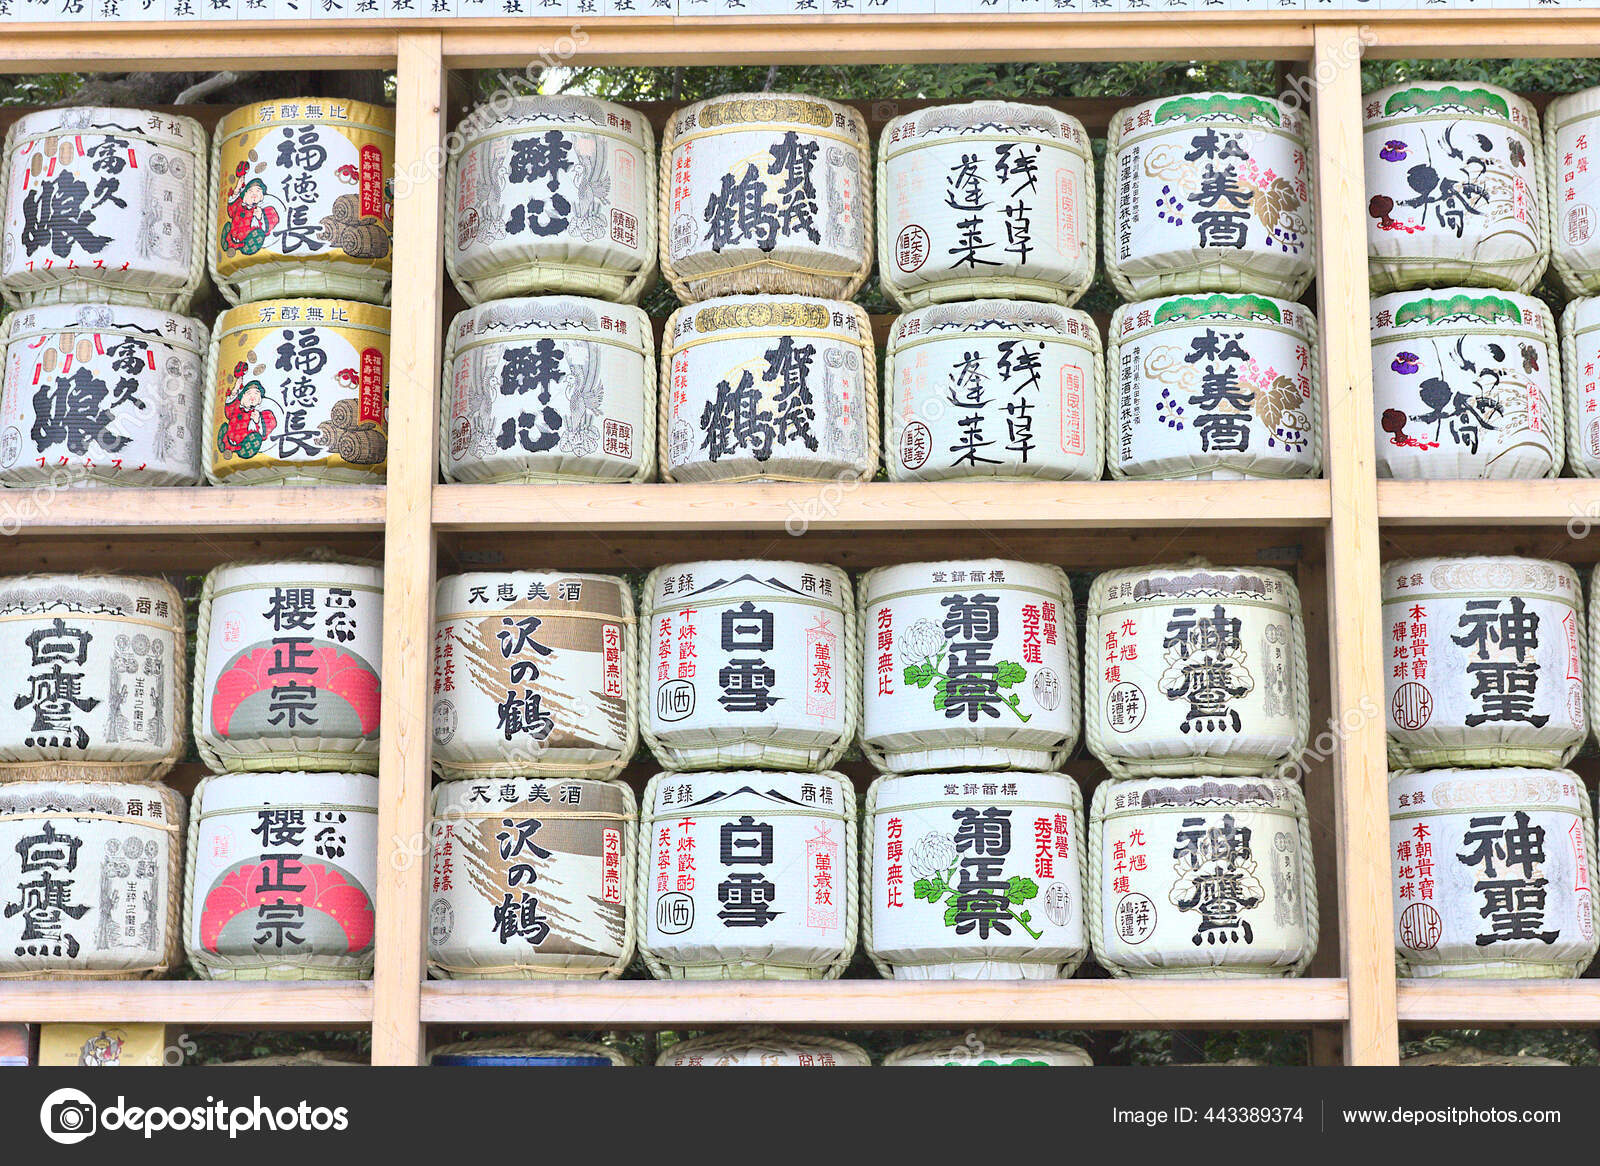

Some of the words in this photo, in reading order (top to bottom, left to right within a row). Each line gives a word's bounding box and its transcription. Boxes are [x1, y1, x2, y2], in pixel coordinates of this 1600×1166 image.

[259, 104, 348, 122] 芳醇無比
[607, 112, 632, 134] 商標
[272, 124, 328, 254] 福徳長
[1120, 154, 1132, 260] 中澤酒造株式会社
[25, 259, 130, 272] フクムスメ
[259, 306, 349, 323] 芳醇無比
[600, 316, 628, 335] 商標
[270, 327, 328, 459] 福徳長
[1295, 345, 1311, 399] 清酒
[1120, 354, 1133, 461] 中澤酒造株式会社
[36, 456, 147, 471] フクムスメ
[136, 596, 168, 618] 商標
[468, 582, 582, 604] 天恵美酒
[801, 573, 833, 597] 商標
[932, 570, 1006, 583] 登録商標
[263, 587, 319, 728] 櫻正宗
[606, 629, 621, 694] 芳醇無比
[657, 618, 672, 682] 芙蓉霞
[717, 601, 786, 712] 白雪
[877, 607, 894, 697] 芳醇無比
[941, 593, 1002, 722] 菊正宗
[1022, 604, 1043, 665] 秀天涯
[1120, 619, 1138, 662] 光輝
[1392, 621, 1409, 681] 輝地球
[1450, 596, 1551, 728] 神聖
[14, 618, 101, 749] 白鷹
[496, 616, 554, 741] 沢の鶴
[1163, 605, 1249, 734] 神鷹
[127, 799, 163, 818] 商標
[469, 784, 582, 804] 天恵美酒
[801, 783, 833, 804] 商標
[944, 783, 1018, 796] 登録商標
[251, 802, 307, 947] 櫻正宗
[605, 833, 619, 899] 芳醇無比
[657, 828, 671, 892] 芙蓉霞
[717, 816, 787, 928] 白雪
[887, 818, 904, 909] 芳醇無比
[952, 807, 1013, 940] 菊正宗
[1034, 817, 1054, 879] 秀天涯
[1129, 828, 1148, 872] 光輝
[1173, 814, 1259, 946] 神鷹
[1397, 840, 1415, 901] 輝地球
[1456, 811, 1560, 946] 神聖
[4, 820, 91, 958] 白鷹
[492, 818, 552, 945] 沢の鶴
